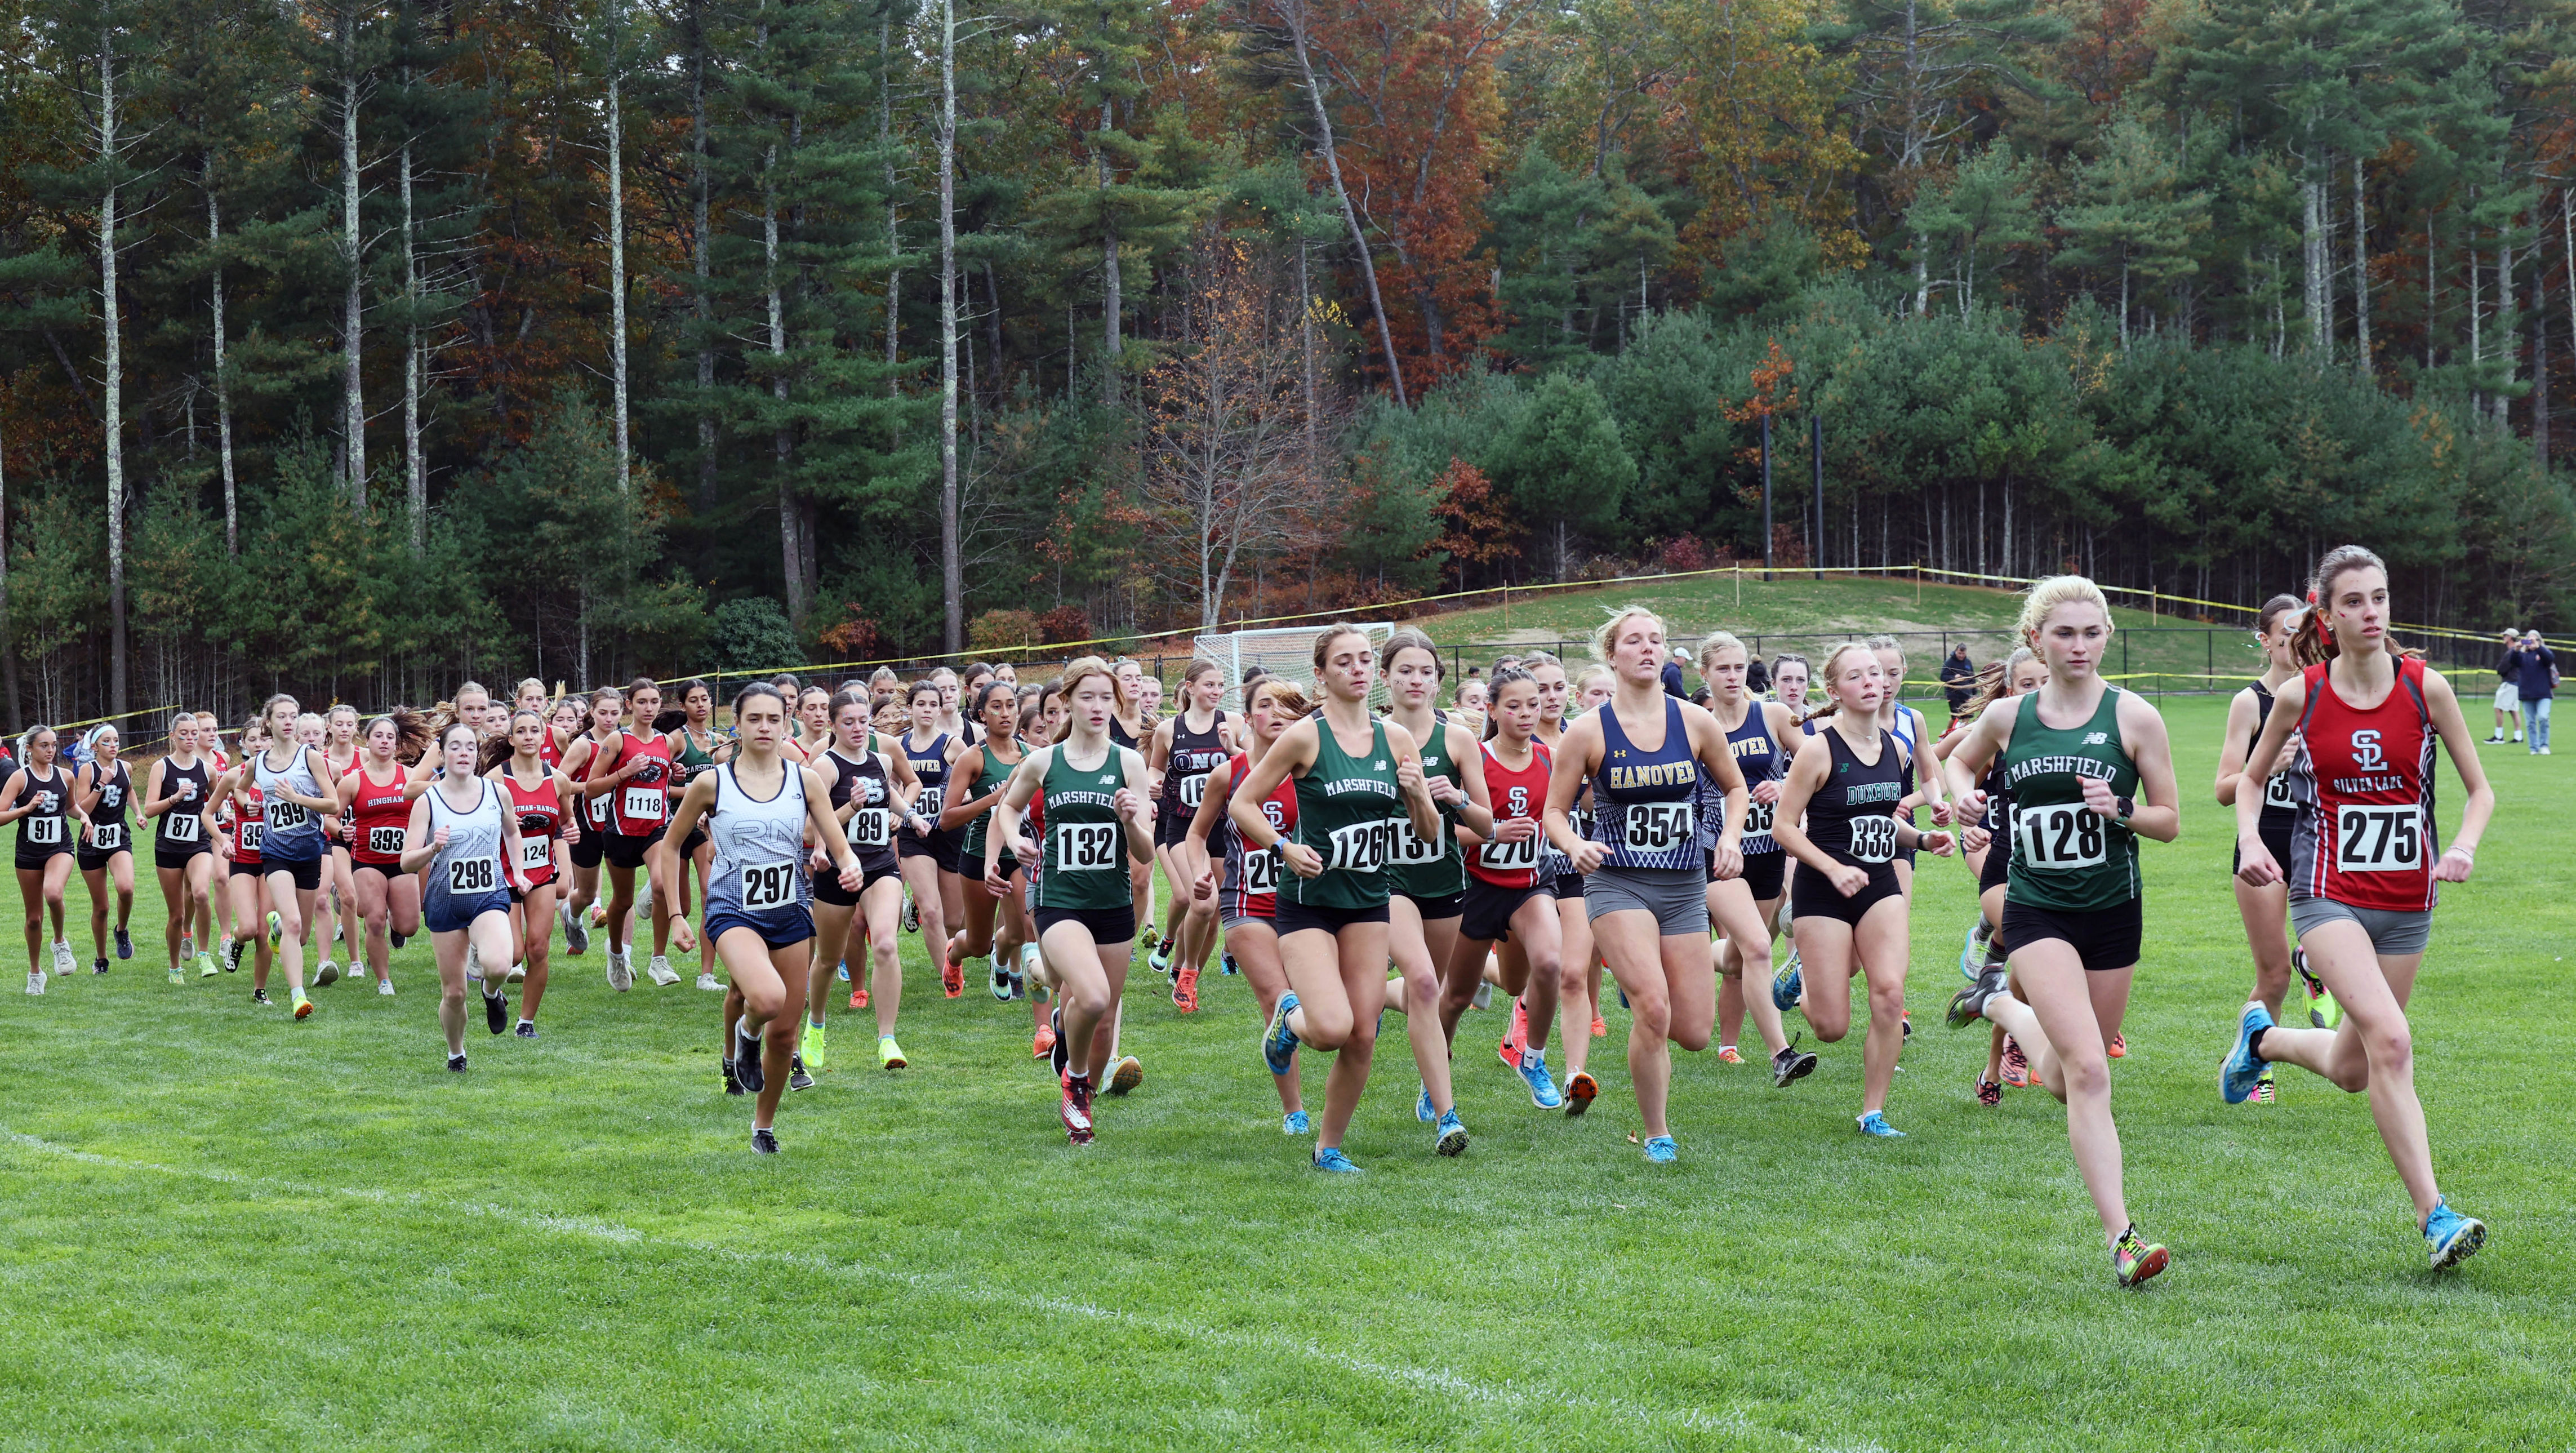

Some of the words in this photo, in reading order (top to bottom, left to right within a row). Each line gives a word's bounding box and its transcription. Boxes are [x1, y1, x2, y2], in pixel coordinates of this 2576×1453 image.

[1729, 737, 1769, 758] OVER
[685, 764, 713, 774] MARSHFI
[908, 759, 941, 772] NOVER
[1610, 760, 1696, 789] HANOVER
[2010, 756, 2117, 783] MARSHFIELD
[1184, 777, 1207, 803] 16
[1324, 779, 1396, 799] MARSHFIELD
[2333, 777, 2374, 793] SILVER
[2374, 775, 2404, 792] LAKE
[367, 796, 404, 807] HINGHAM
[515, 805, 559, 816] TMAN-HANSON
[594, 802, 607, 815] 11
[628, 796, 661, 812] 1118
[916, 790, 939, 815] 56
[1048, 791, 1114, 810] MARSHFIEL
[172, 816, 193, 837] 87
[270, 802, 305, 828] 299
[857, 812, 882, 841] 89
[1629, 806, 1690, 847] 354
[1743, 798, 1773, 832] 53
[34, 820, 52, 840] 91
[98, 827, 115, 846] 84
[243, 825, 264, 846] 39
[371, 829, 404, 851] 393
[1853, 818, 1896, 857] 333
[2026, 807, 2102, 861] 128
[2342, 811, 2417, 863] 275
[523, 844, 547, 861] 124
[1061, 828, 1113, 865] 132
[1336, 825, 1384, 868] 126
[451, 859, 492, 890] 298
[1249, 853, 1284, 888] 26
[745, 863, 794, 905] 297
